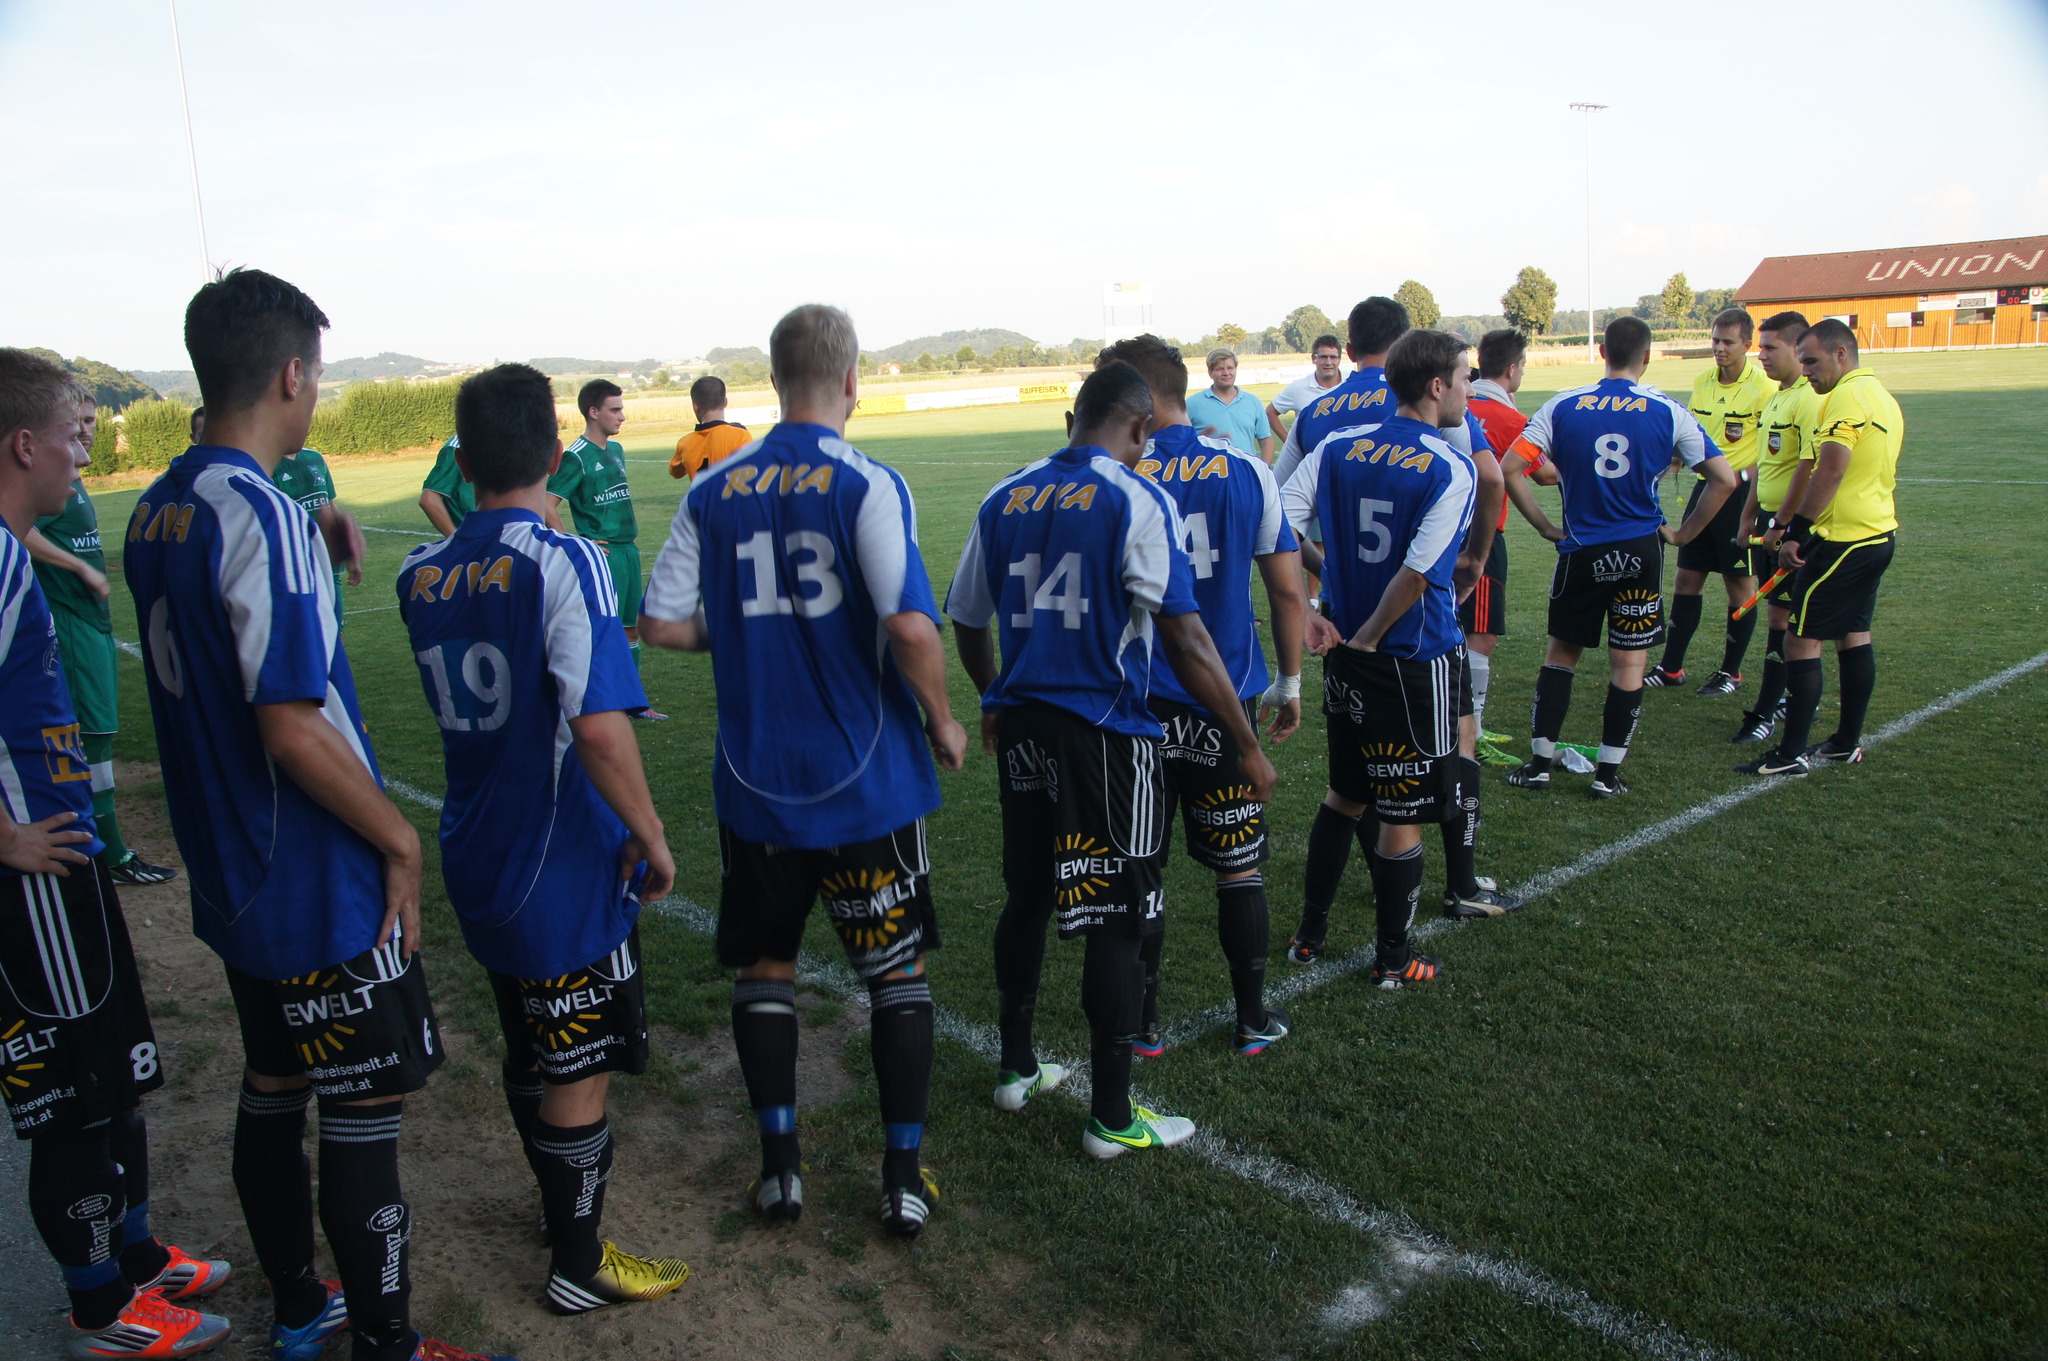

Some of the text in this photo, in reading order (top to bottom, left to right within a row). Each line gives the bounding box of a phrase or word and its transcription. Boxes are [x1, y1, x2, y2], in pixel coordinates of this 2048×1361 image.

[1866, 249, 2046, 282] UNION
[1020, 385, 1058, 394] RAIFFEISEN
[1312, 388, 1388, 419] RIVA
[1575, 395, 1648, 413] RIVA
[1133, 455, 1229, 484] RIVA
[1345, 439, 1434, 473] RIVA
[1594, 433, 1631, 479] 8
[722, 463, 834, 500] RIVA
[1003, 482, 1098, 516] RIVA
[1358, 498, 1394, 564] 5
[410, 555, 514, 603] RIVA
[736, 530, 844, 619] 13
[1592, 550, 1642, 575] BWS
[1009, 552, 1089, 630] 14
[149, 595, 184, 699] 6
[416, 642, 512, 731] 19
[1463, 812, 1475, 847] Allianz
[423, 1017, 433, 1056] 6
[130, 1041, 158, 1081] 8
[574, 1167, 599, 1218] Allianz
[89, 1216, 111, 1266] llianz
[382, 1229, 401, 1295] Allianz
